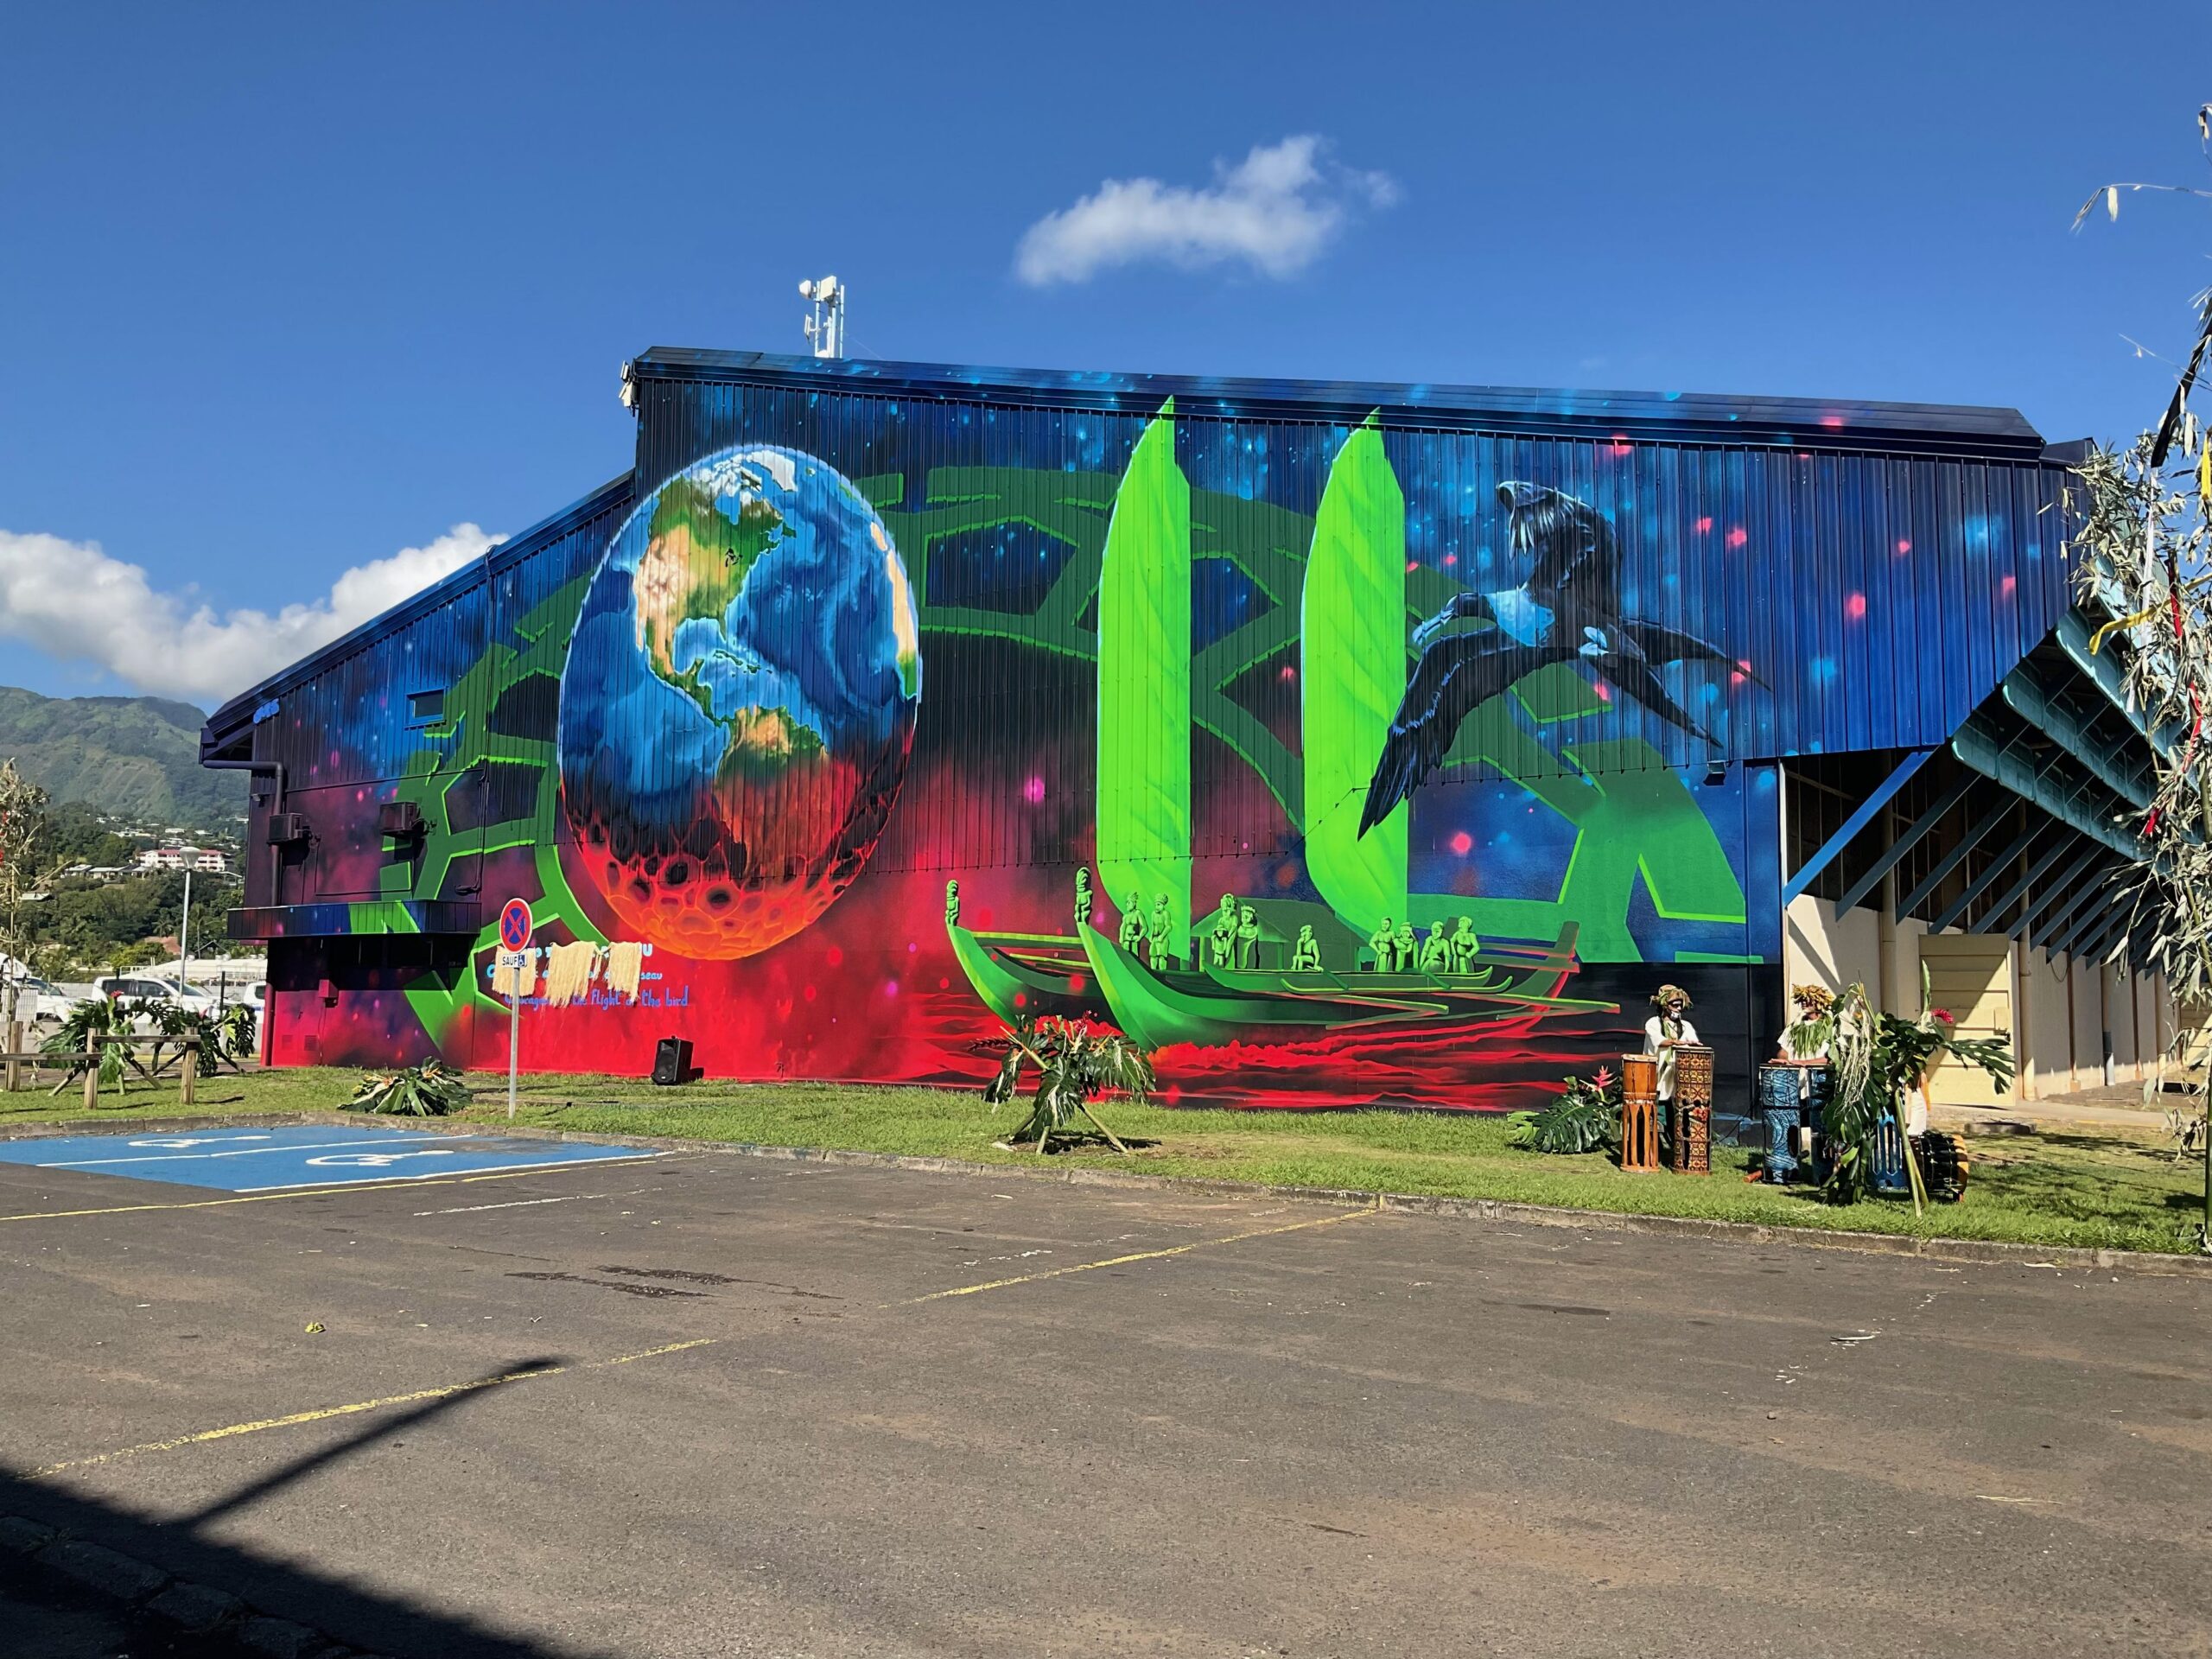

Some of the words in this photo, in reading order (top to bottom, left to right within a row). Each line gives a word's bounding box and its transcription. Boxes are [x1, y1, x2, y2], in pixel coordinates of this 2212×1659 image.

[502, 956, 518, 966] SAUF
[642, 988, 661, 1007] the
[665, 984, 689, 1007] bird
